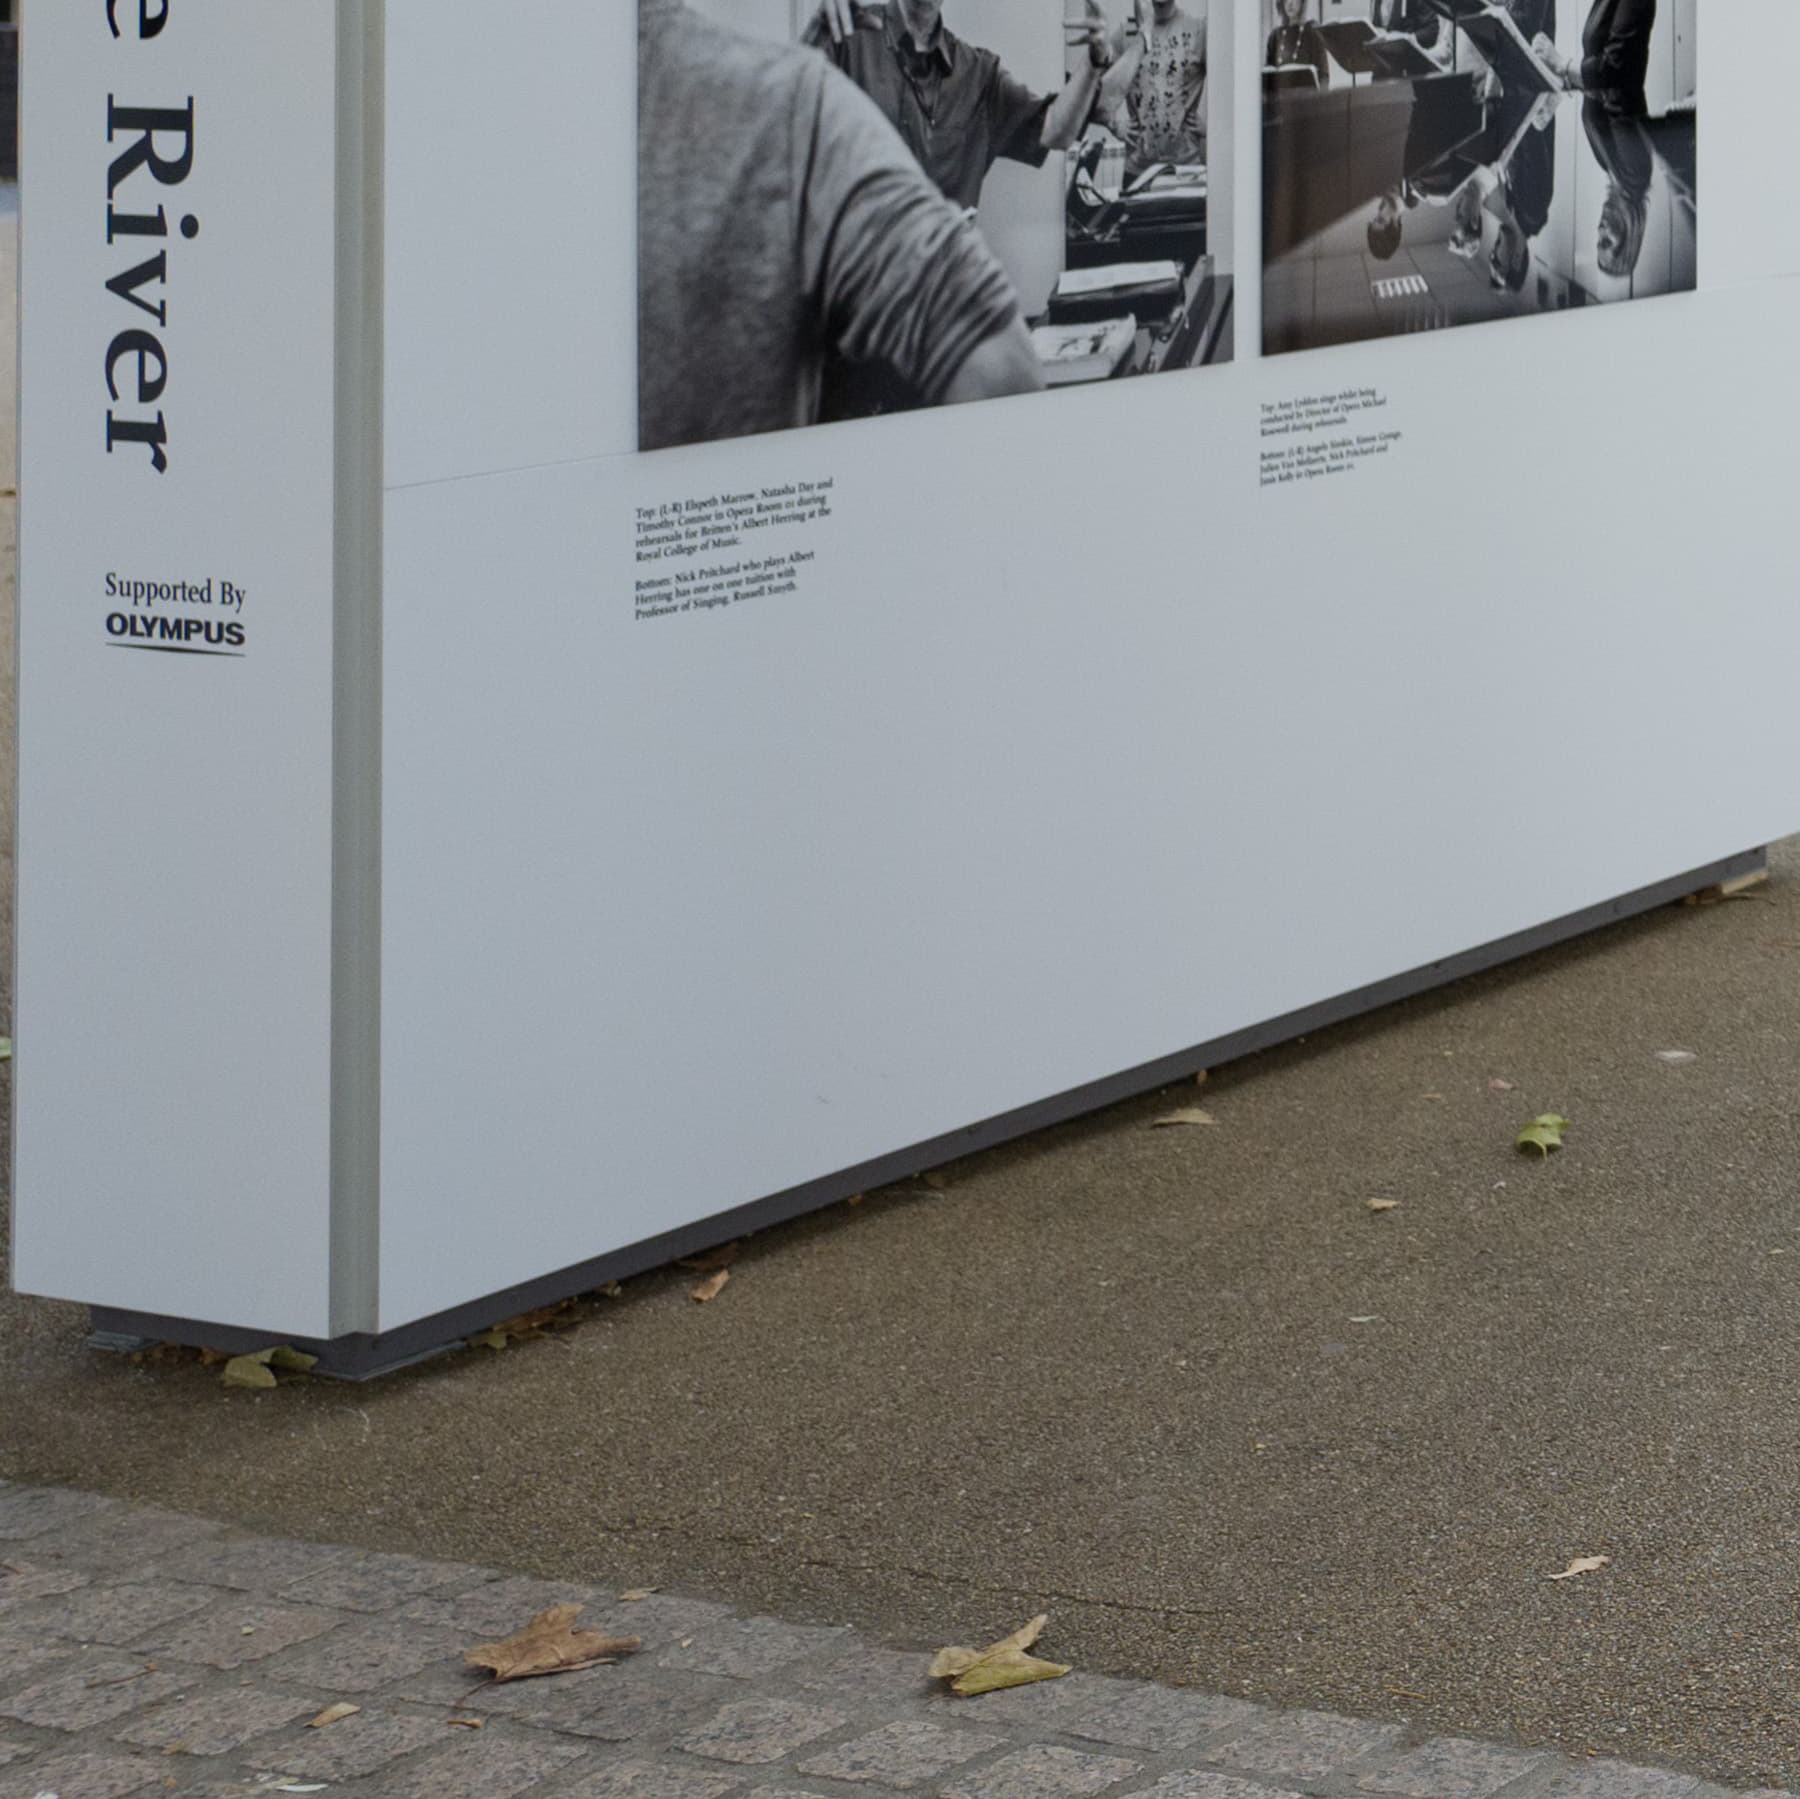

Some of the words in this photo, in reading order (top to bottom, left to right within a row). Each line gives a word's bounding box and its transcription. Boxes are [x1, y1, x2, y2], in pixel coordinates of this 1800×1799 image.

[105, 94, 198, 473] River
[798, 482, 814, 493] Day
[816, 477, 833, 490] and
[636, 517, 675, 533] Timothy
[714, 510, 724, 520] in
[726, 507, 754, 521] Opera
[756, 503, 782, 512] Room
[797, 495, 826, 511] during
[636, 532, 682, 548] rehearsals
[685, 528, 698, 539] for
[742, 518, 768, 529] Albert
[771, 512, 806, 525] Herring
[808, 510, 815, 518] at
[818, 507, 831, 517] the
[636, 547, 661, 562] Royal
[664, 544, 698, 557] College
[700, 539, 711, 551] of
[675, 571, 696, 582] Nick
[742, 560, 762, 571] who
[764, 556, 785, 571] plays
[788, 551, 814, 564] Albert
[106, 572, 212, 607] Supported
[221, 581, 245, 614] By
[635, 592, 673, 605] Herring
[675, 587, 691, 597] has
[693, 585, 710, 594] one
[712, 582, 724, 591] on
[726, 580, 743, 588] one
[745, 573, 774, 584] tuition
[777, 567, 796, 578] with
[635, 604, 678, 620] Professor
[681, 599, 691, 611] of
[106, 612, 245, 645] OLYMPUS
